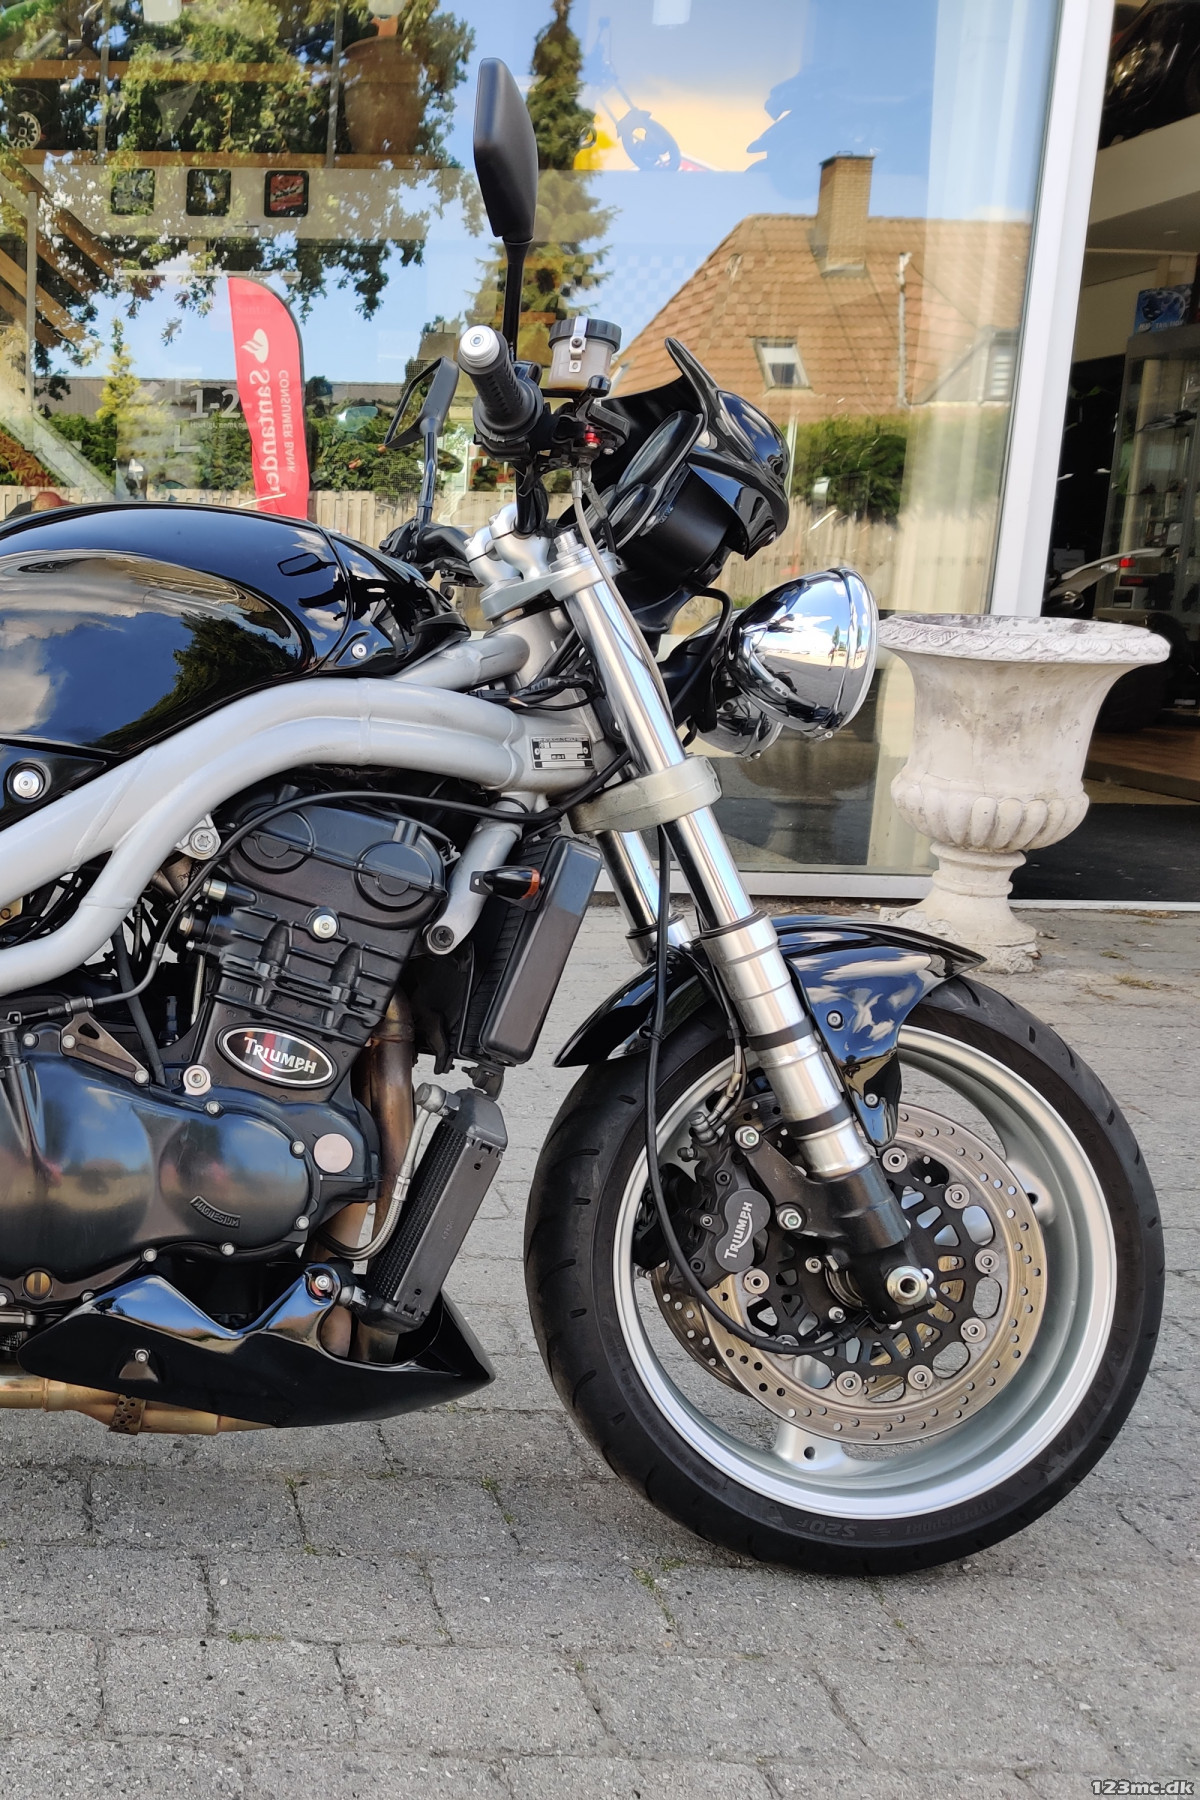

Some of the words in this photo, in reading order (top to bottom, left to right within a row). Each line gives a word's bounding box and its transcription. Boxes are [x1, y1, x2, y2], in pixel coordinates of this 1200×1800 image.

[243, 1036, 318, 1074] TRIUMPH
[193, 1199, 240, 1228] MAGNESIUM
[723, 1200, 753, 1259] TRIUMPH
